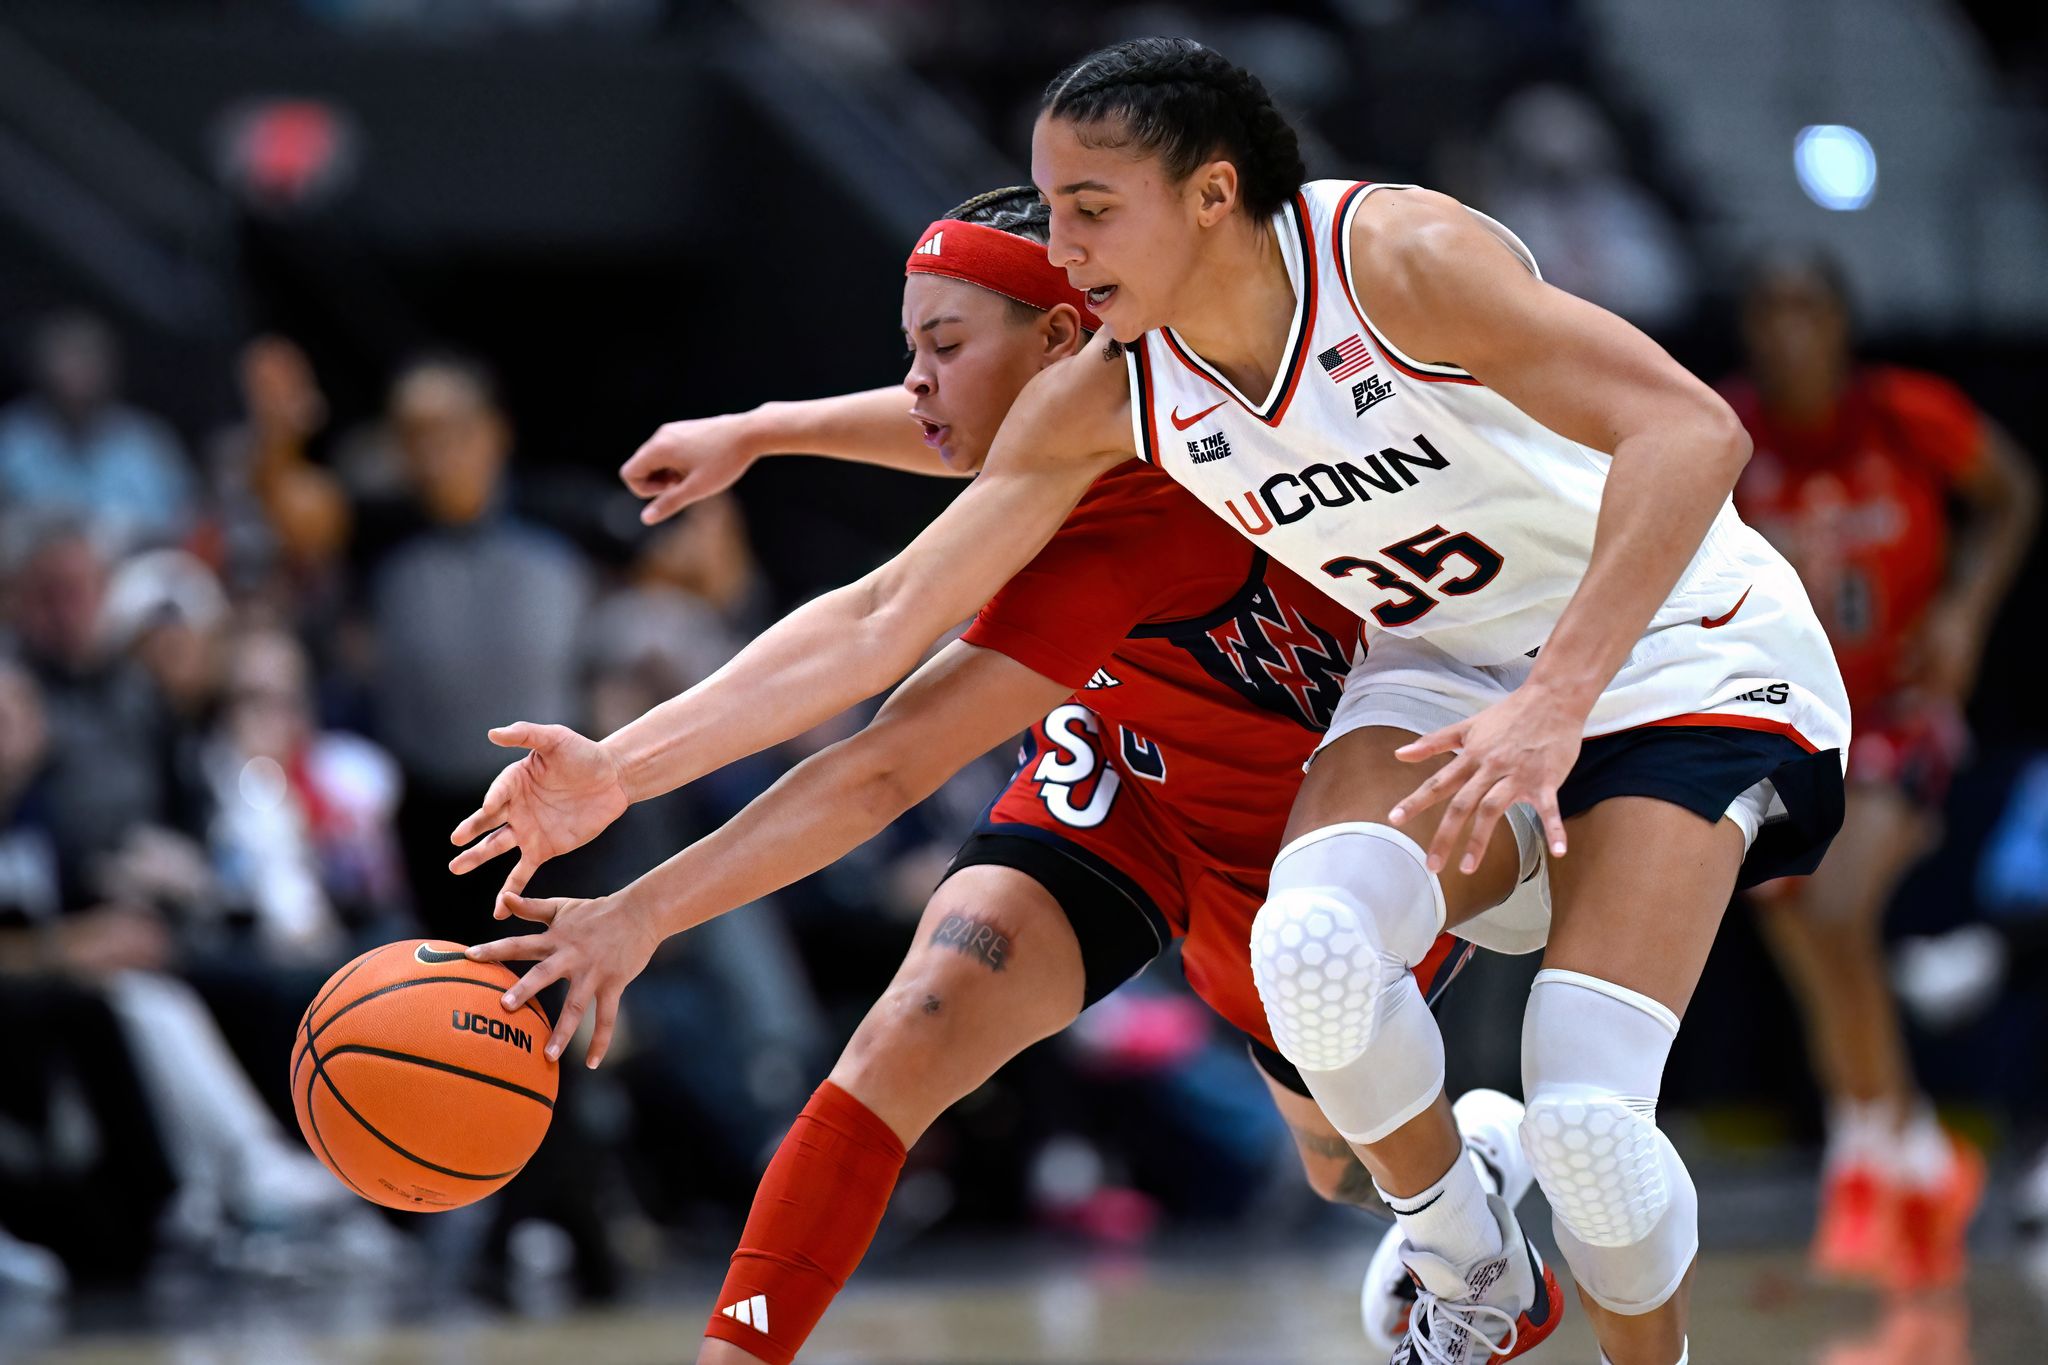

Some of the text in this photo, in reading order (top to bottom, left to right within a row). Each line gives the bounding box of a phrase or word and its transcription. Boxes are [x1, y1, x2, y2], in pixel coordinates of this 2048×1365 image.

[1352, 374, 1380, 399] BIG
[1354, 380, 1392, 411] EAST
[1186, 431, 1226, 453] BE THE
[1225, 434, 1451, 535] UCONN
[1320, 524, 1505, 628] 35
[936, 917, 1009, 964] RARE
[452, 1009, 532, 1054] UCONN
